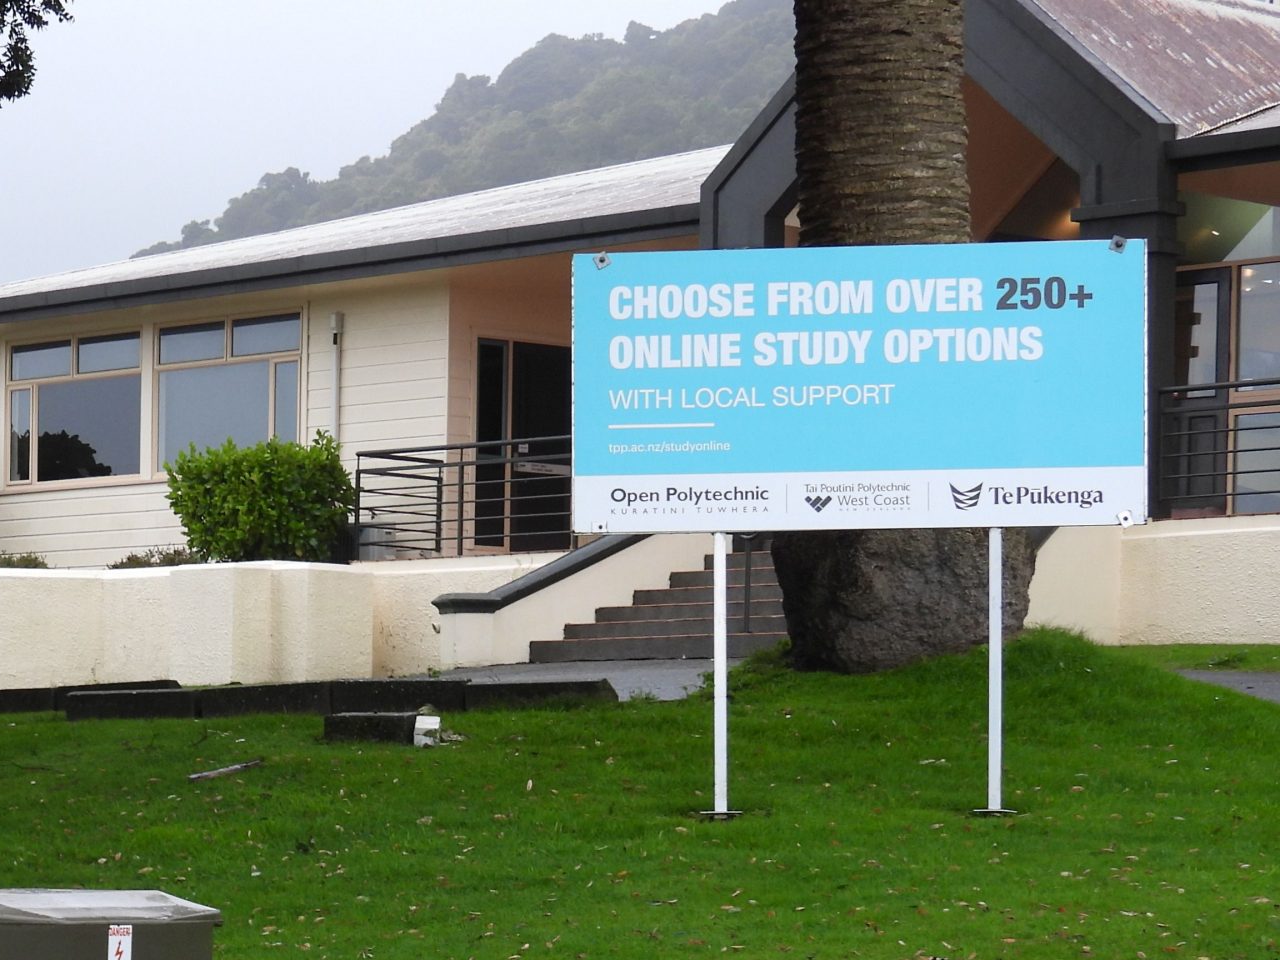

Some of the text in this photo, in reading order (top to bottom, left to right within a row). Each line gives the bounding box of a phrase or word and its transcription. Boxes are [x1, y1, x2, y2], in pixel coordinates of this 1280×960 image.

[609, 276, 1093, 320] CHOOSE FROM OVER 250+
[609, 326, 1044, 370] ONLINE STUDY OPTIONS
[609, 384, 895, 410] WITH LOCAL SUPPORT
[608, 440, 731, 455] tpp.ac.nz/studyonline
[610, 485, 769, 507] Open Polytechnic
[804, 482, 911, 495] Tai Poutini Polytechnic
[837, 494, 911, 506] West Coast
[610, 506, 769, 515] KURATINI TUWHERA
